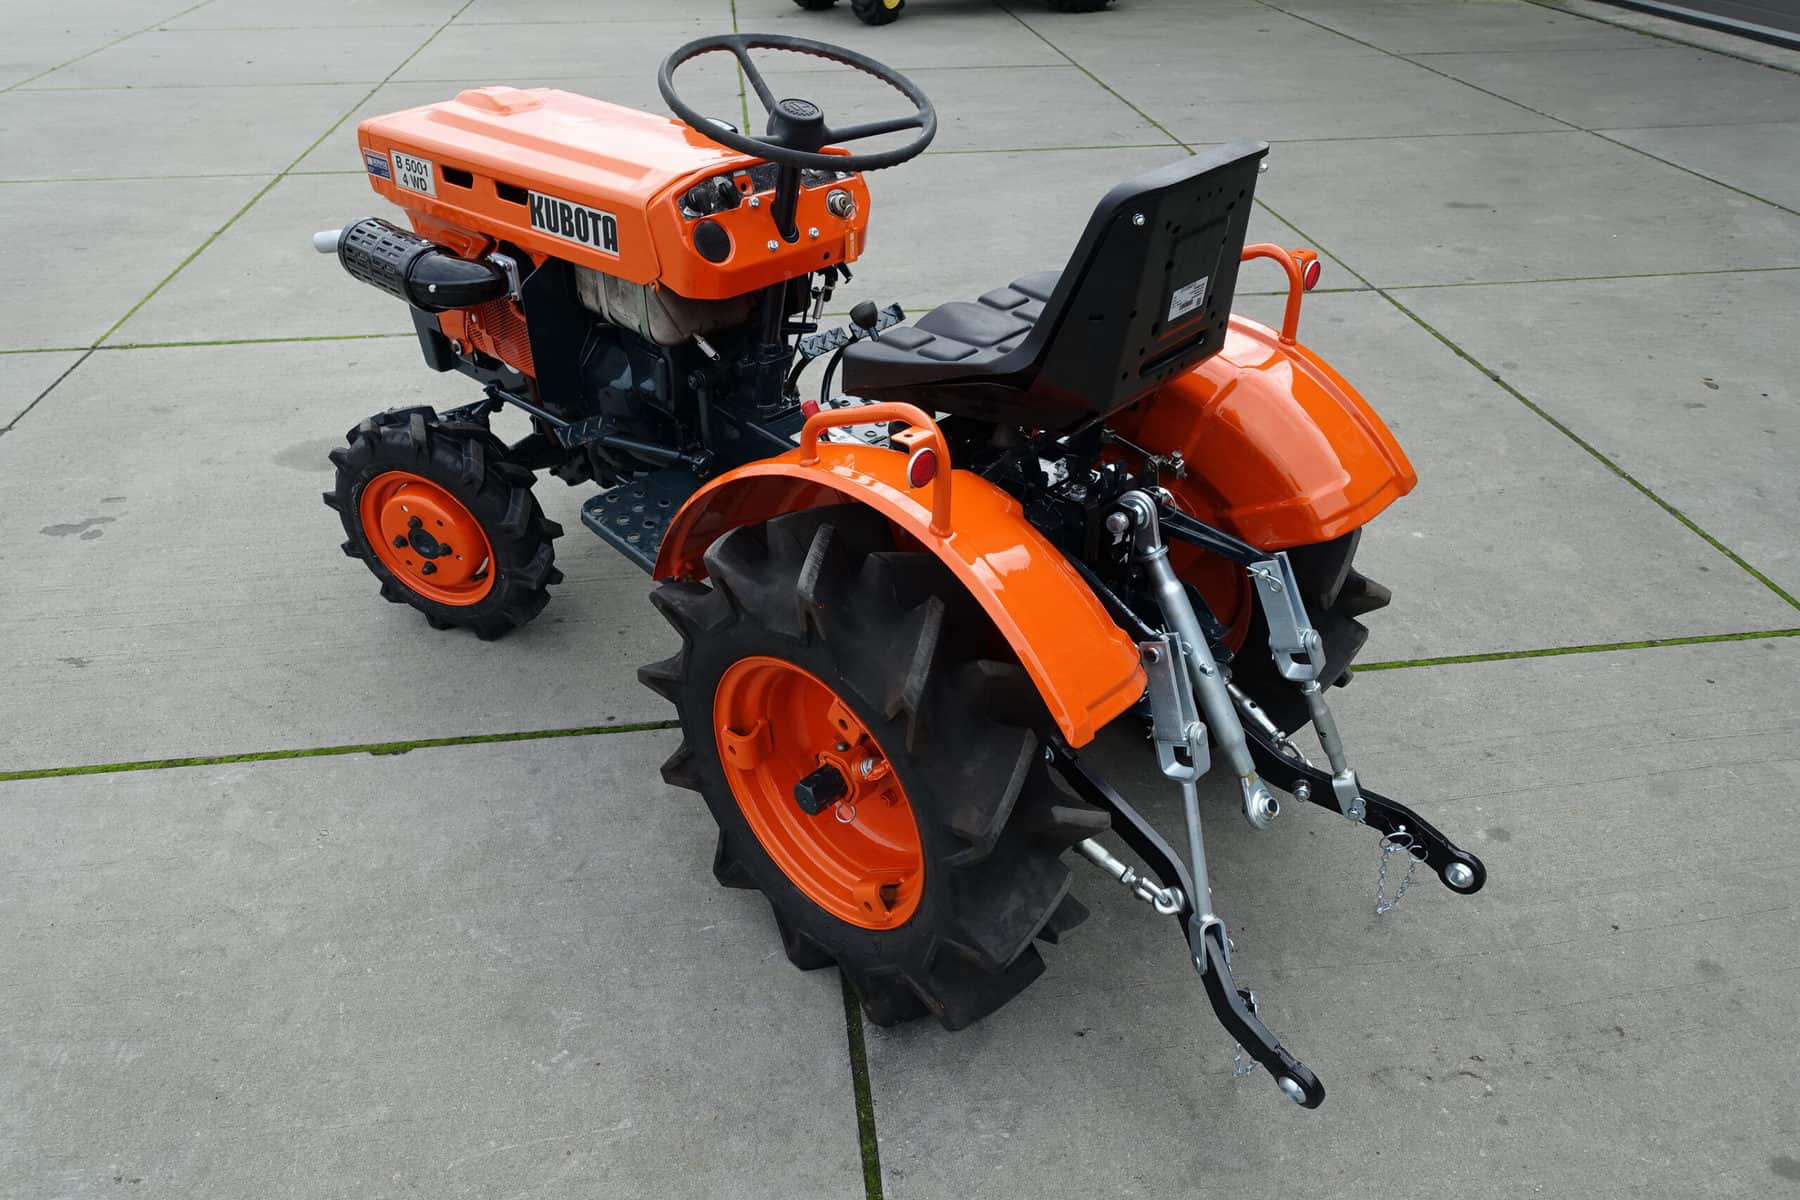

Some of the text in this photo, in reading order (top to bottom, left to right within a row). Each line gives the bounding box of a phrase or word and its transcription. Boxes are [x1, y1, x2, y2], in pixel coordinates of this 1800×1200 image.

[395, 155, 403, 169] B
[405, 158, 428, 177] 5001
[402, 173, 428, 192] 4 WD
[529, 192, 618, 253] KUBOTA
